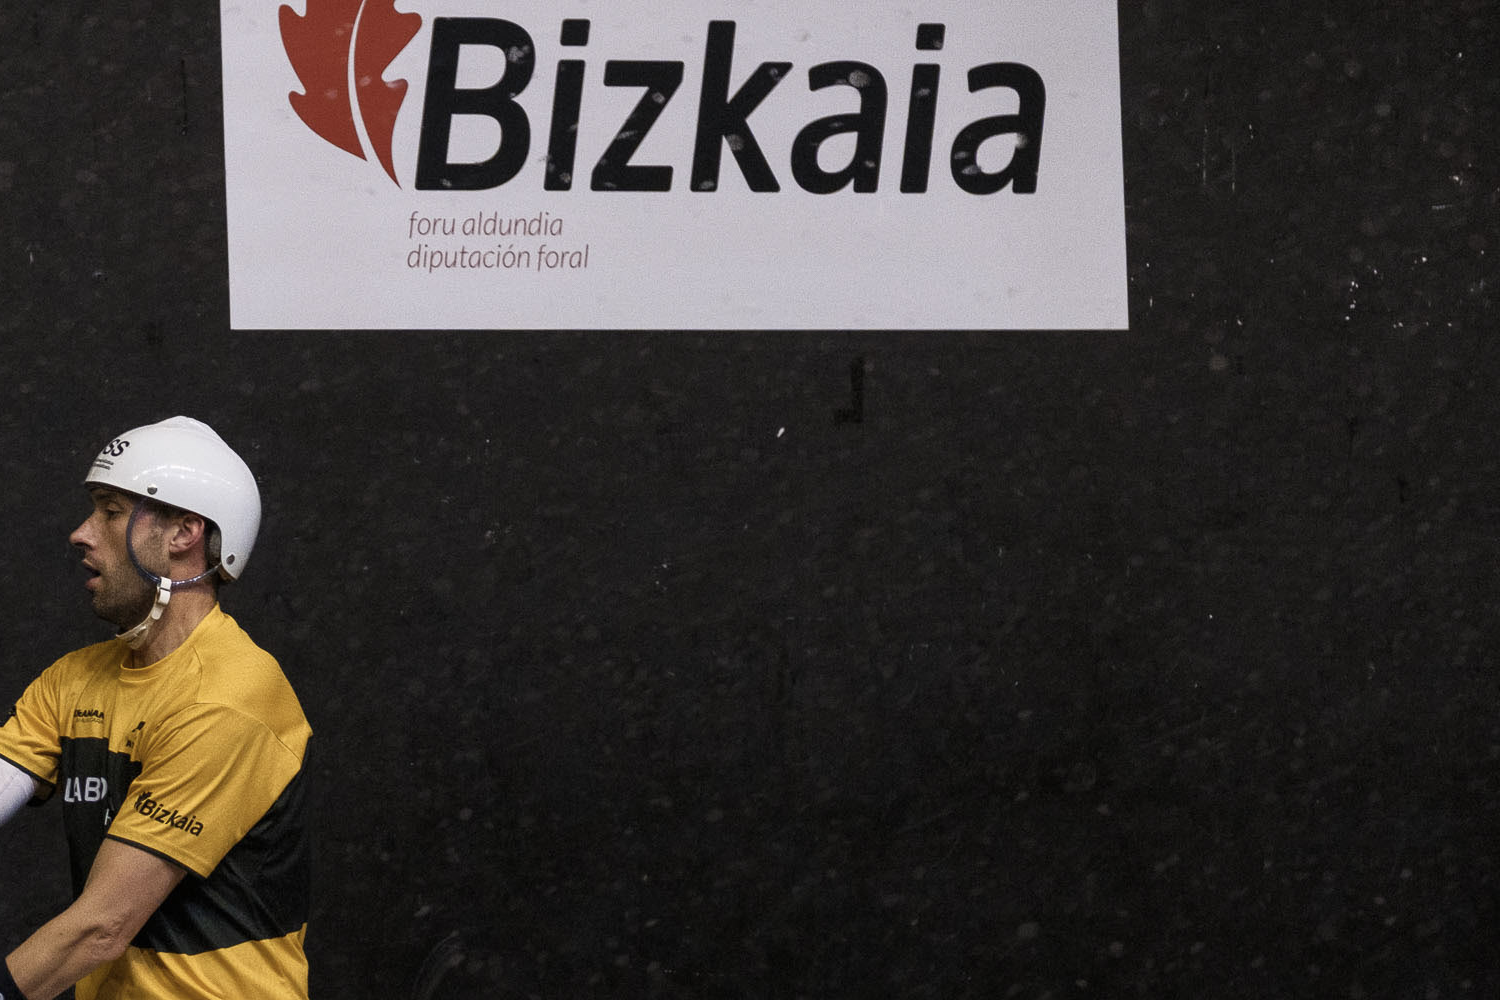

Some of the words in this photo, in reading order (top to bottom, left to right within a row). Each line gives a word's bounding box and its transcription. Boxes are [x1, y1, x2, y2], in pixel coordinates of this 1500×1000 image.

[414, 16, 1047, 196] Bizkaia
[408, 210, 456, 239] foru
[461, 210, 564, 237] aldundia
[406, 243, 531, 274] diputación
[536, 243, 591, 272] foral
[138, 798, 205, 837] Bizkaia
